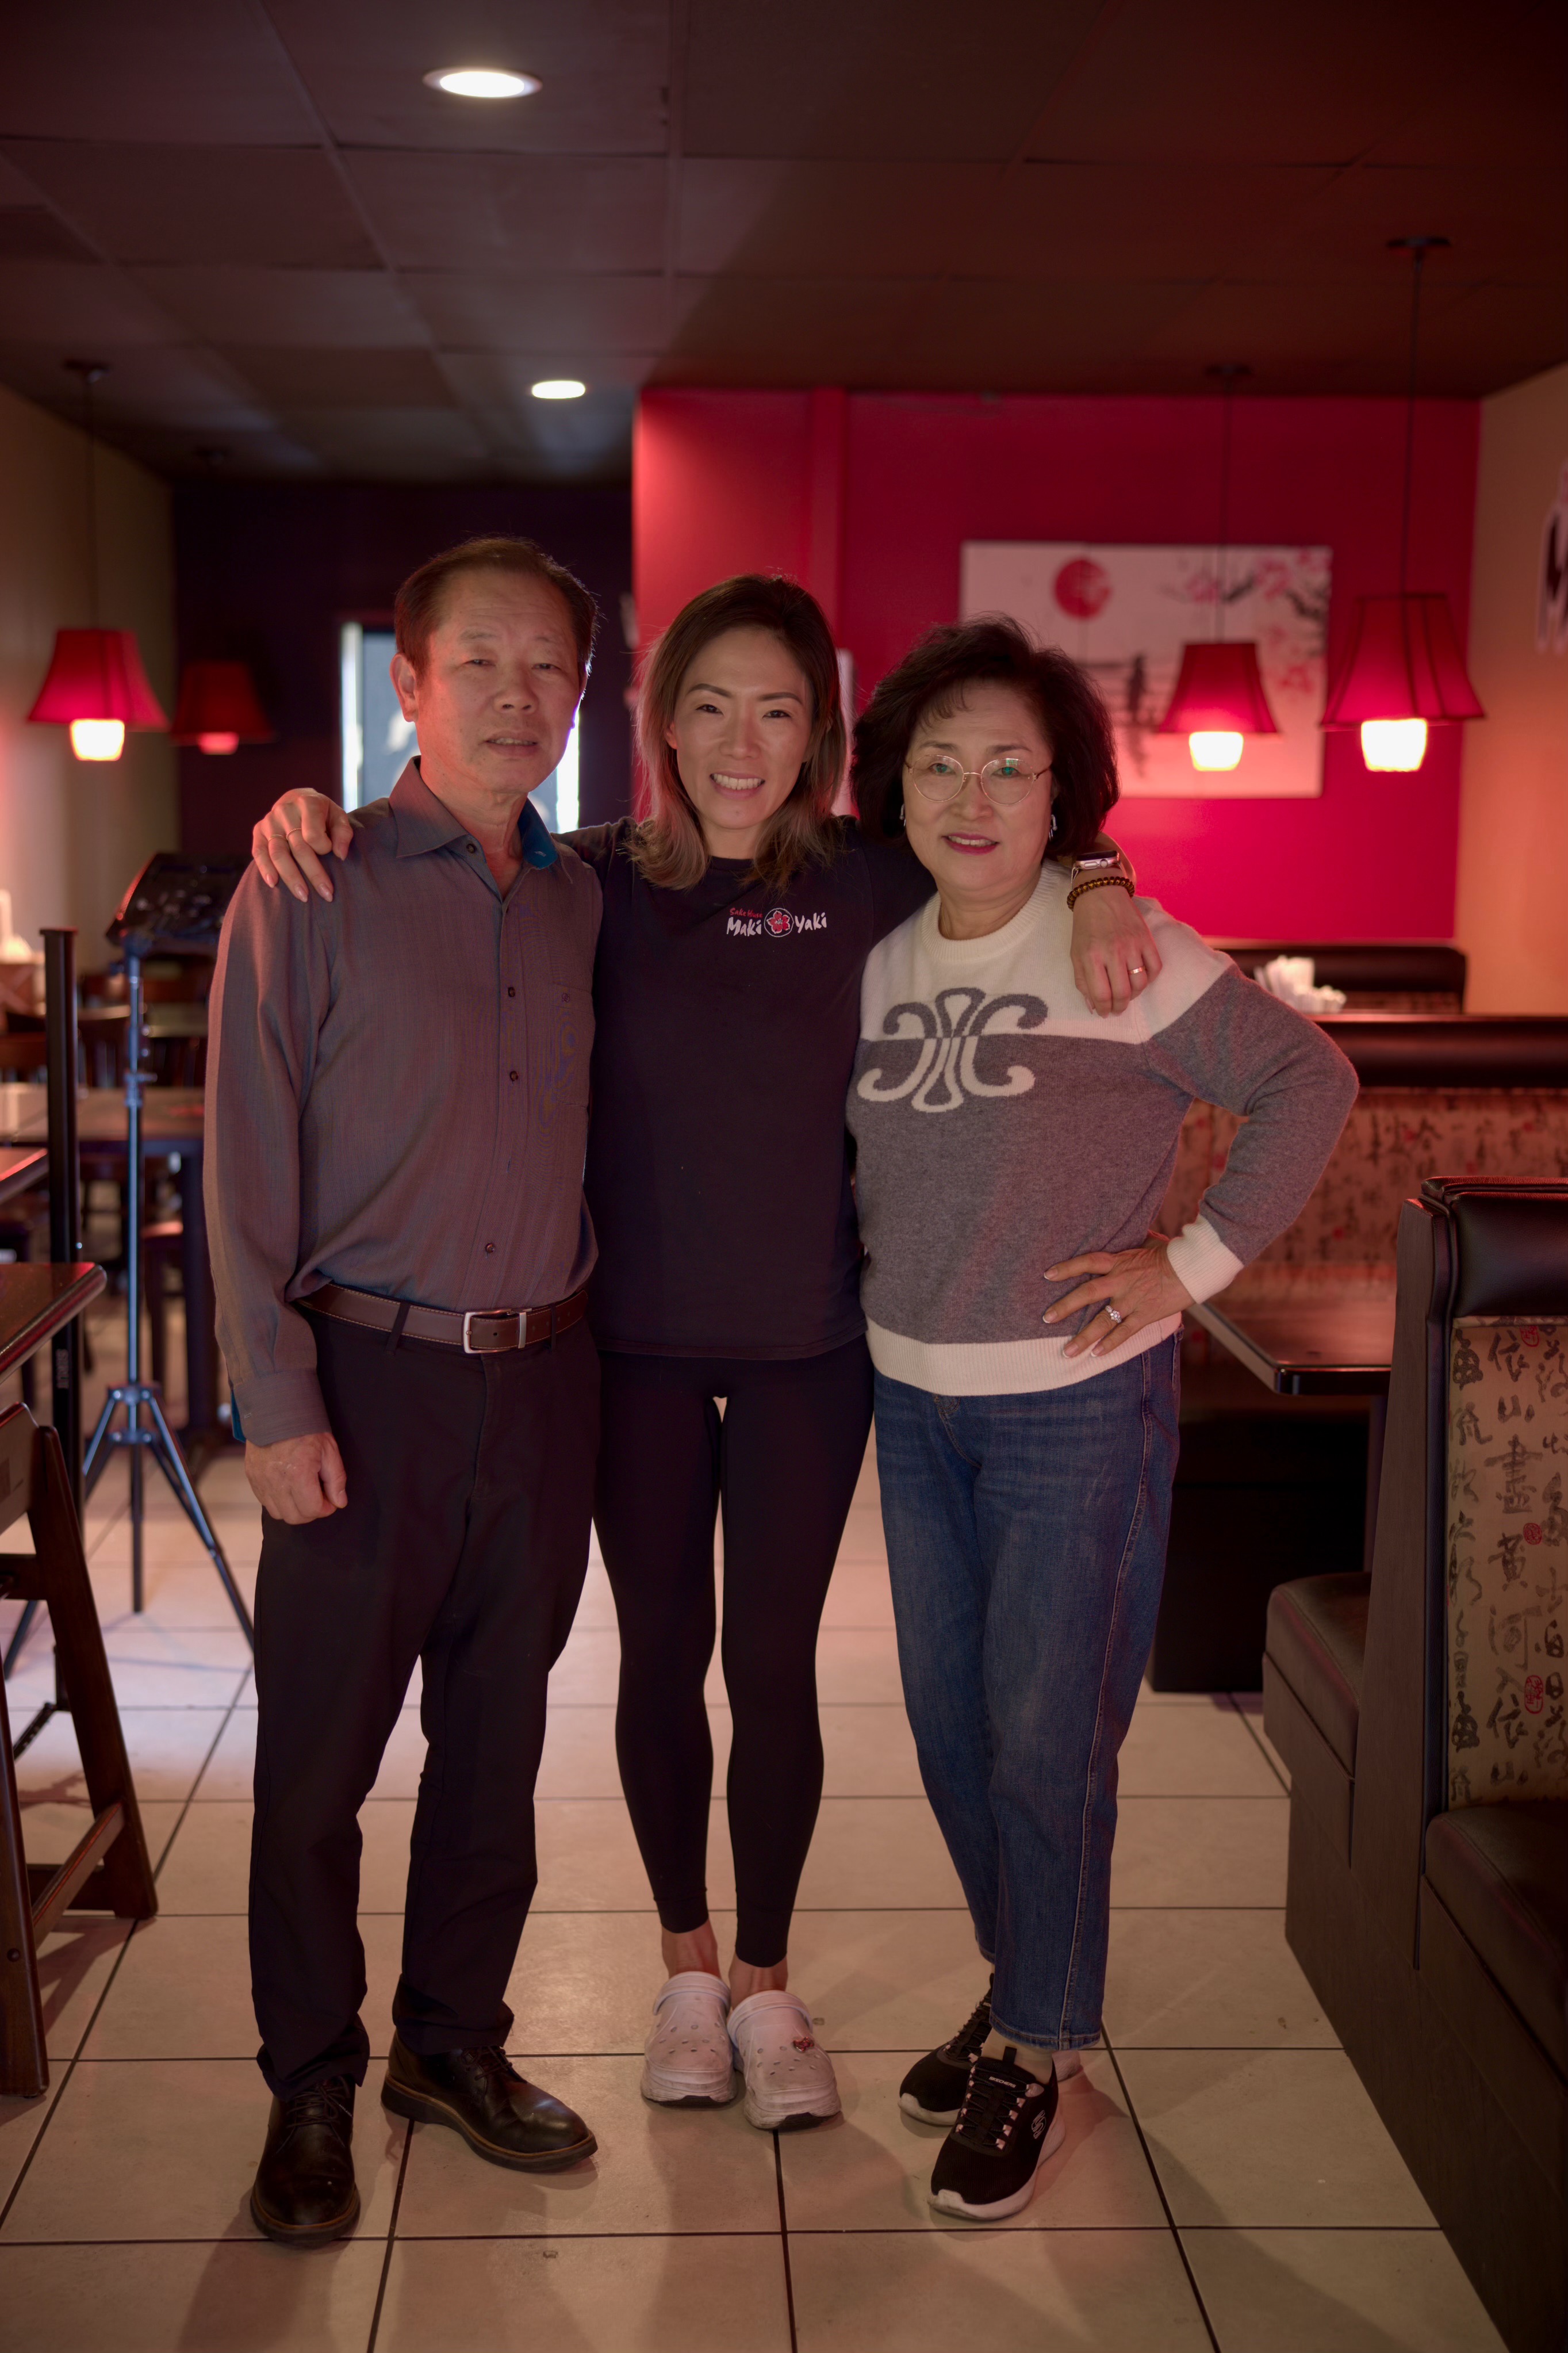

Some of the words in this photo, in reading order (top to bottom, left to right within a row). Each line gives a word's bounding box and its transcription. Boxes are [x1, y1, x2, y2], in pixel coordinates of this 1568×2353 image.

[730, 908, 746, 916] Sake
[727, 917, 761, 936] Maki
[795, 912, 827, 933] Yaki
[988, 2076, 1017, 2088] SKECHERS
